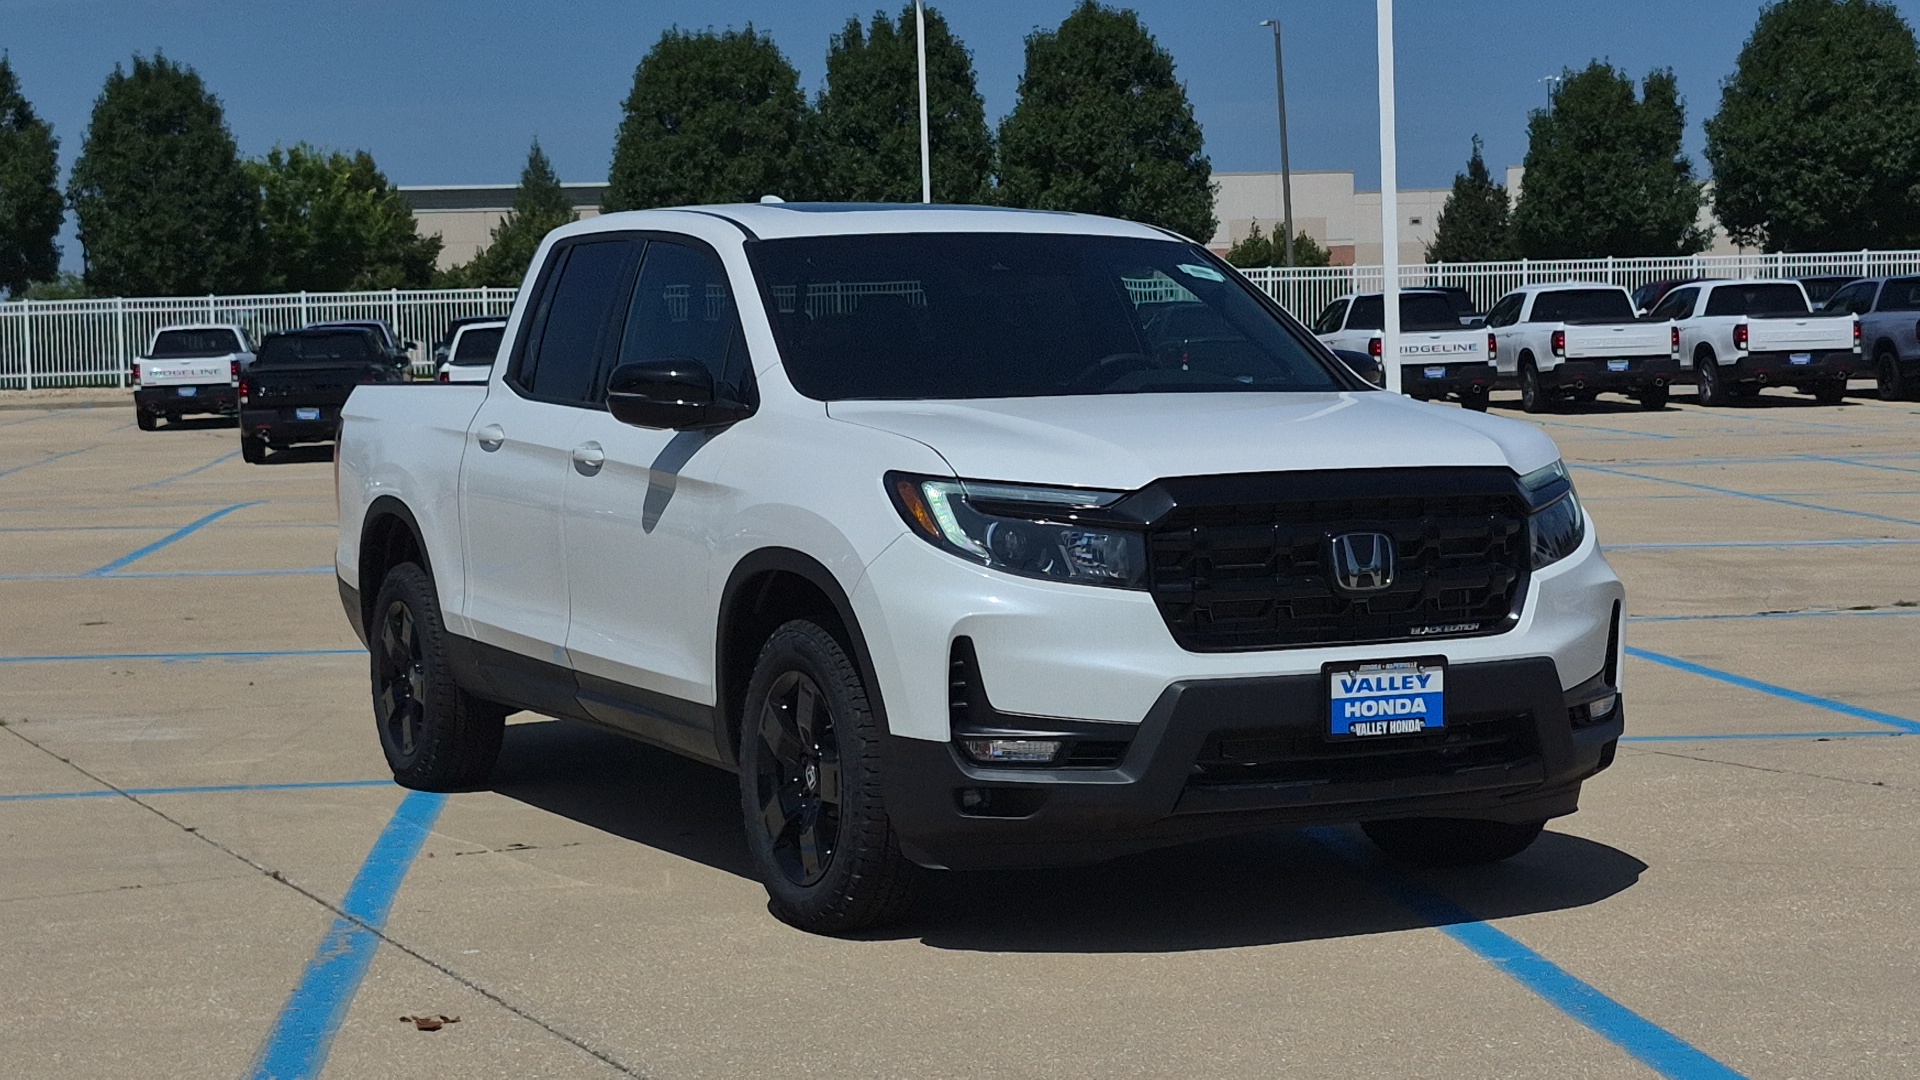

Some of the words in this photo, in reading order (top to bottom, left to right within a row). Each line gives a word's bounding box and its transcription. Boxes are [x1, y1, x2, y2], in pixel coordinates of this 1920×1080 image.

[1340, 674, 1431, 694] VALLEY
[1344, 697, 1427, 718] HONDA
[1355, 721, 1388, 736] VALLEY
[1389, 719, 1421, 734] HONDA
